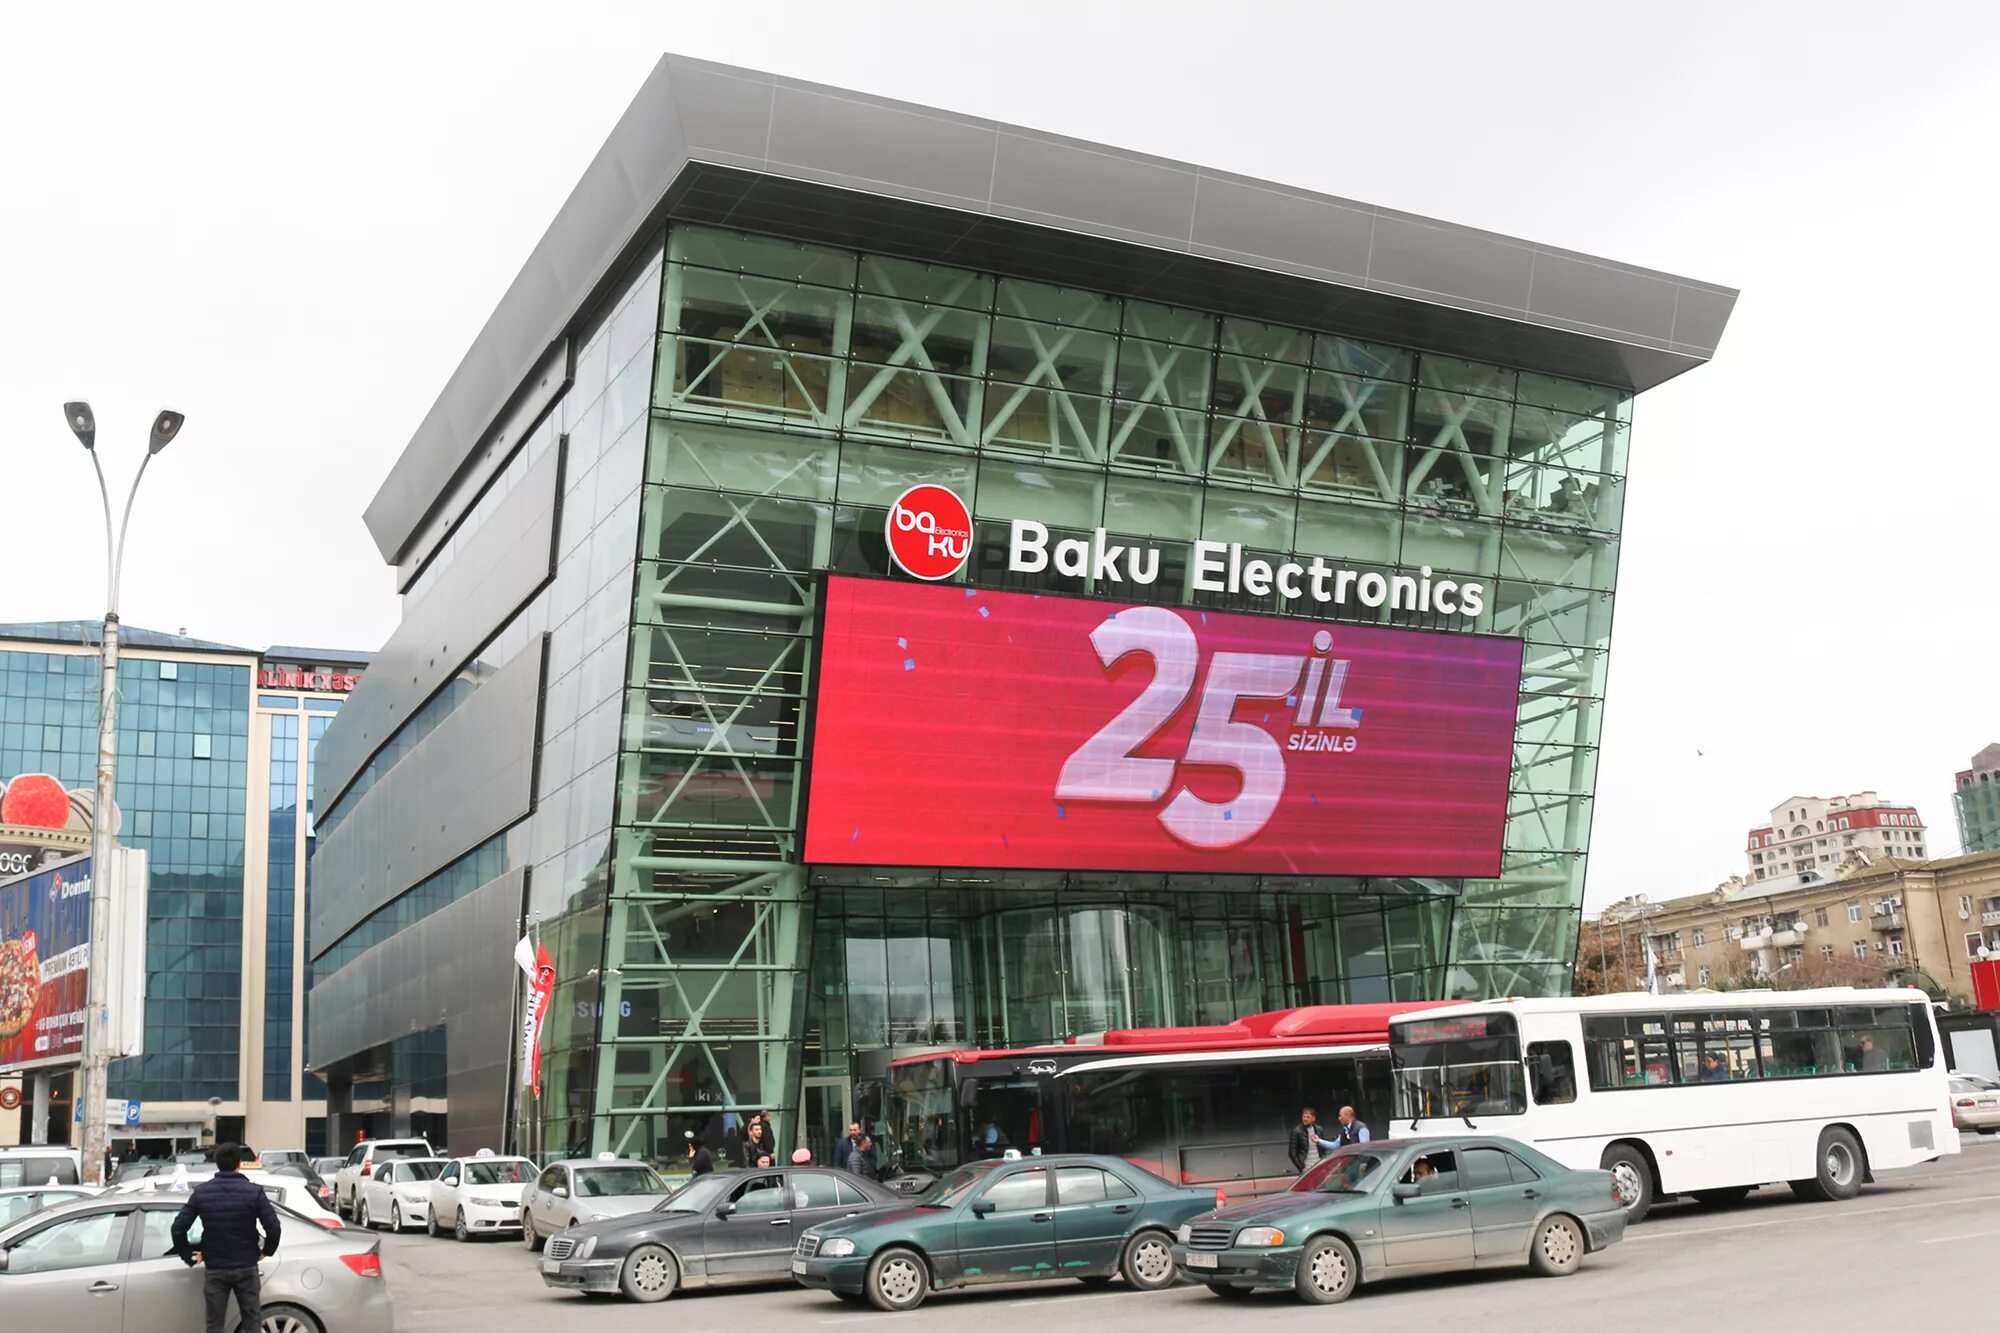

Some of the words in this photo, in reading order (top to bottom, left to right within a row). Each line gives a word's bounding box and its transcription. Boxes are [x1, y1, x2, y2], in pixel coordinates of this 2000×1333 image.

[1008, 519, 1160, 585] Baku
[1192, 540, 1484, 617] Electronics
[1054, 606, 1308, 848] 25
[1293, 629, 1360, 728] İL
[1287, 730, 1358, 752] SİZİNLƏ
[130, 1108, 138, 1117] P
